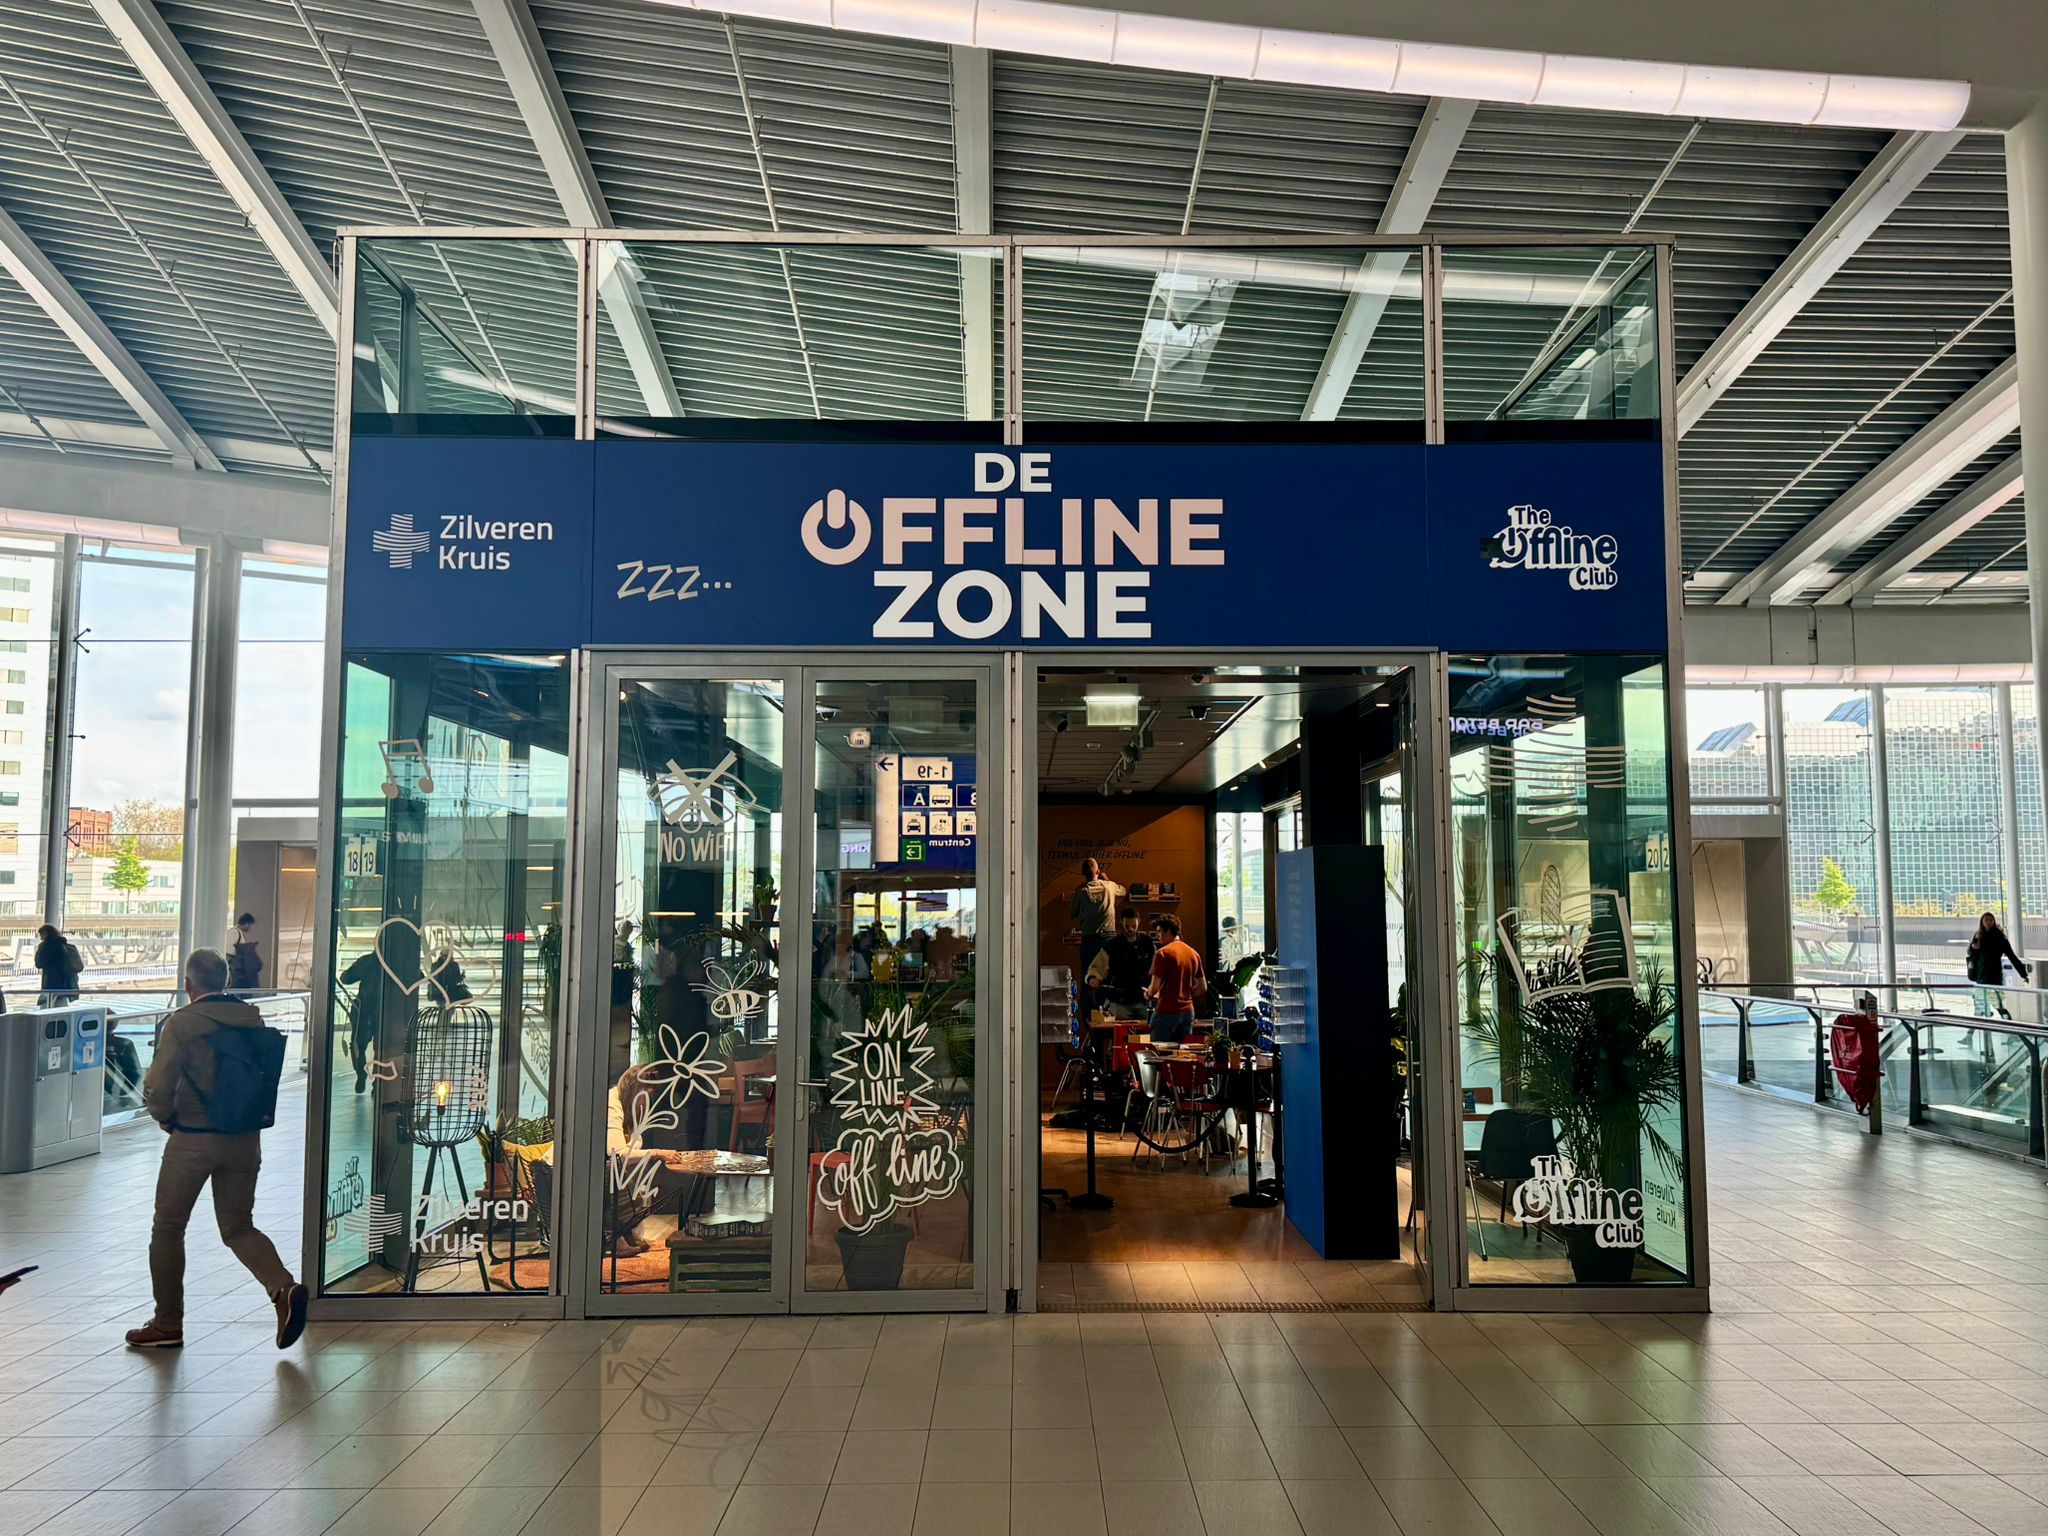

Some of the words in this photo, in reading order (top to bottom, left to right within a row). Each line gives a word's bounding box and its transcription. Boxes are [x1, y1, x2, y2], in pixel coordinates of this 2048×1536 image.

[974, 453, 1052, 493] DE
[440, 515, 554, 542] Zilveren
[801, 489, 1226, 566] OFFLINE
[1508, 505, 1551, 528] The
[438, 543, 511, 571] Kruis
[1490, 526, 1618, 569] Offline
[1569, 566, 1618, 590] Club
[872, 570, 1152, 639] ZONE
[347, 851, 359, 873] 18
[363, 851, 374, 873] 19
[1647, 848, 1659, 869] 20
[863, 1041, 901, 1080] ON
[860, 1077, 904, 1107] LINE
[412, 1194, 529, 1222] Zilveren
[410, 1226, 484, 1254] Kruis
[1595, 1219, 1645, 1248] Club
